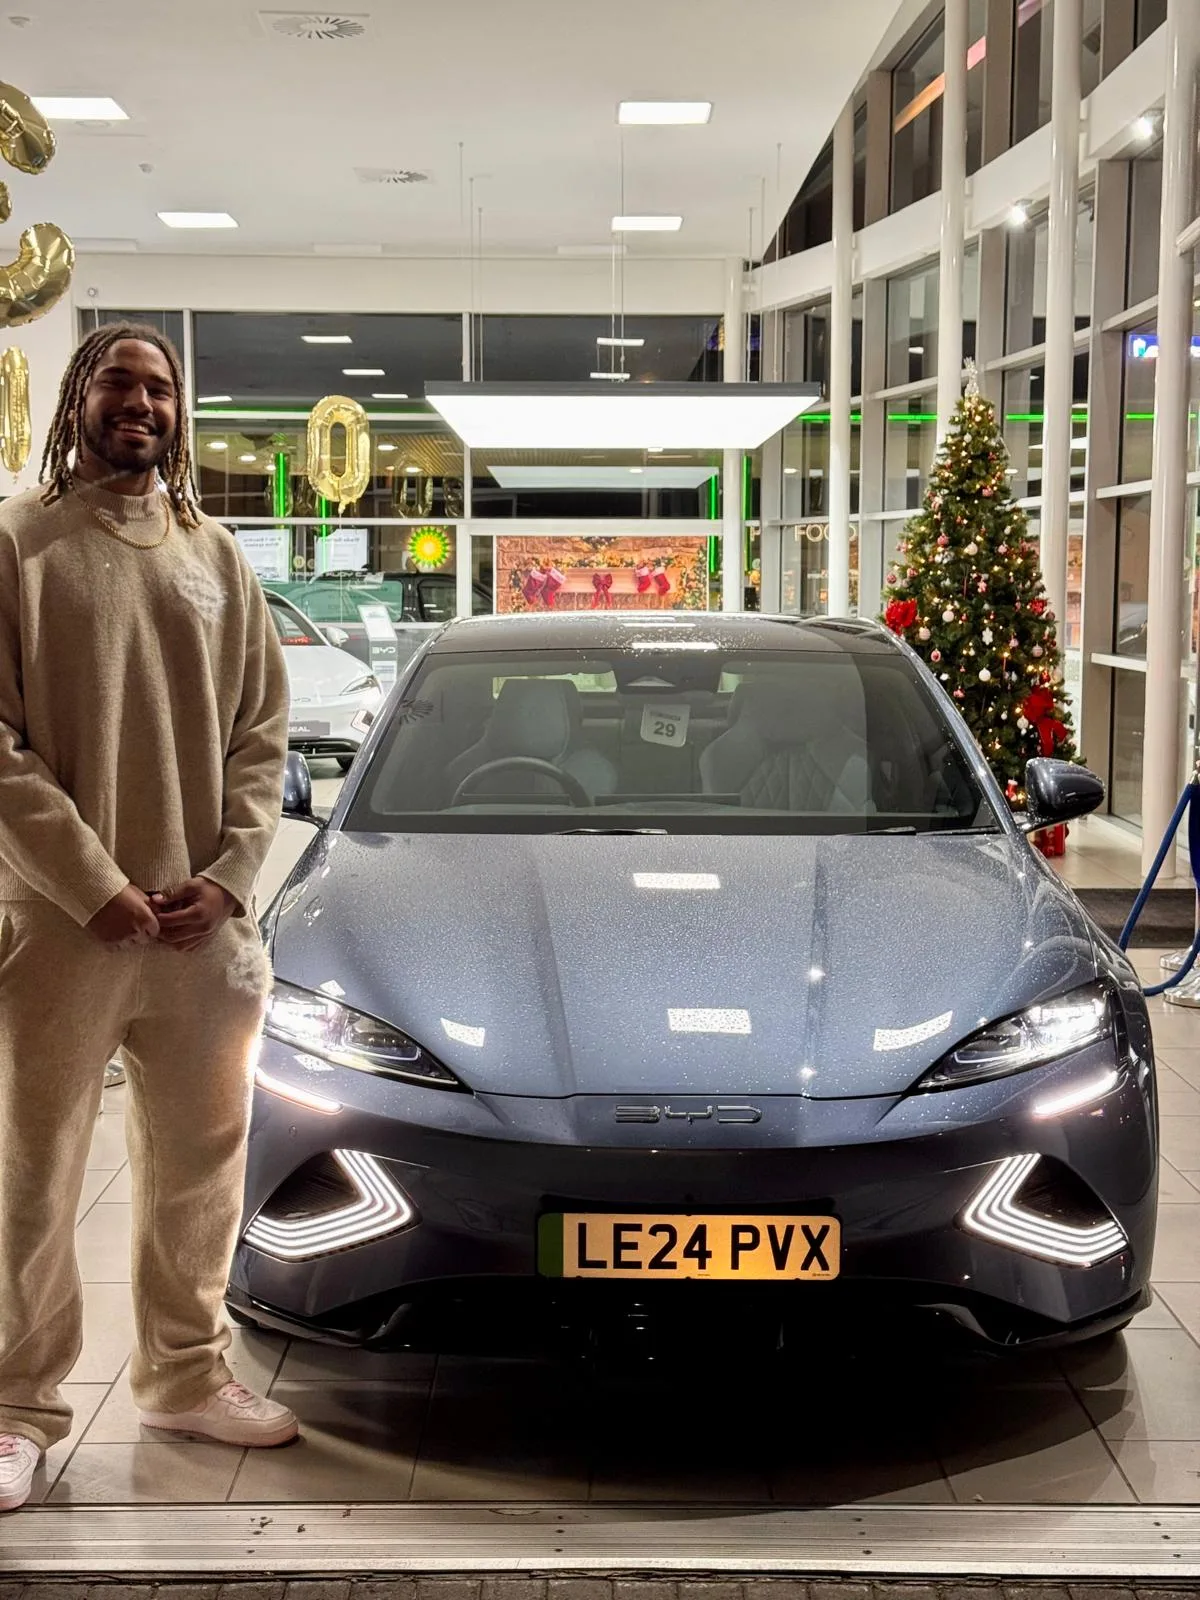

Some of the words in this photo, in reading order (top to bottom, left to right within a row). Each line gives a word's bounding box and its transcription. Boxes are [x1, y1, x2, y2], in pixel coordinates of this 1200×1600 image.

[794, 523, 857, 542] FOD
[371, 646, 396, 654] BYD
[653, 720, 676, 738] 29
[615, 1104, 762, 1124] BYD
[577, 1222, 713, 1270] LE24
[730, 1223, 831, 1272] PVX
